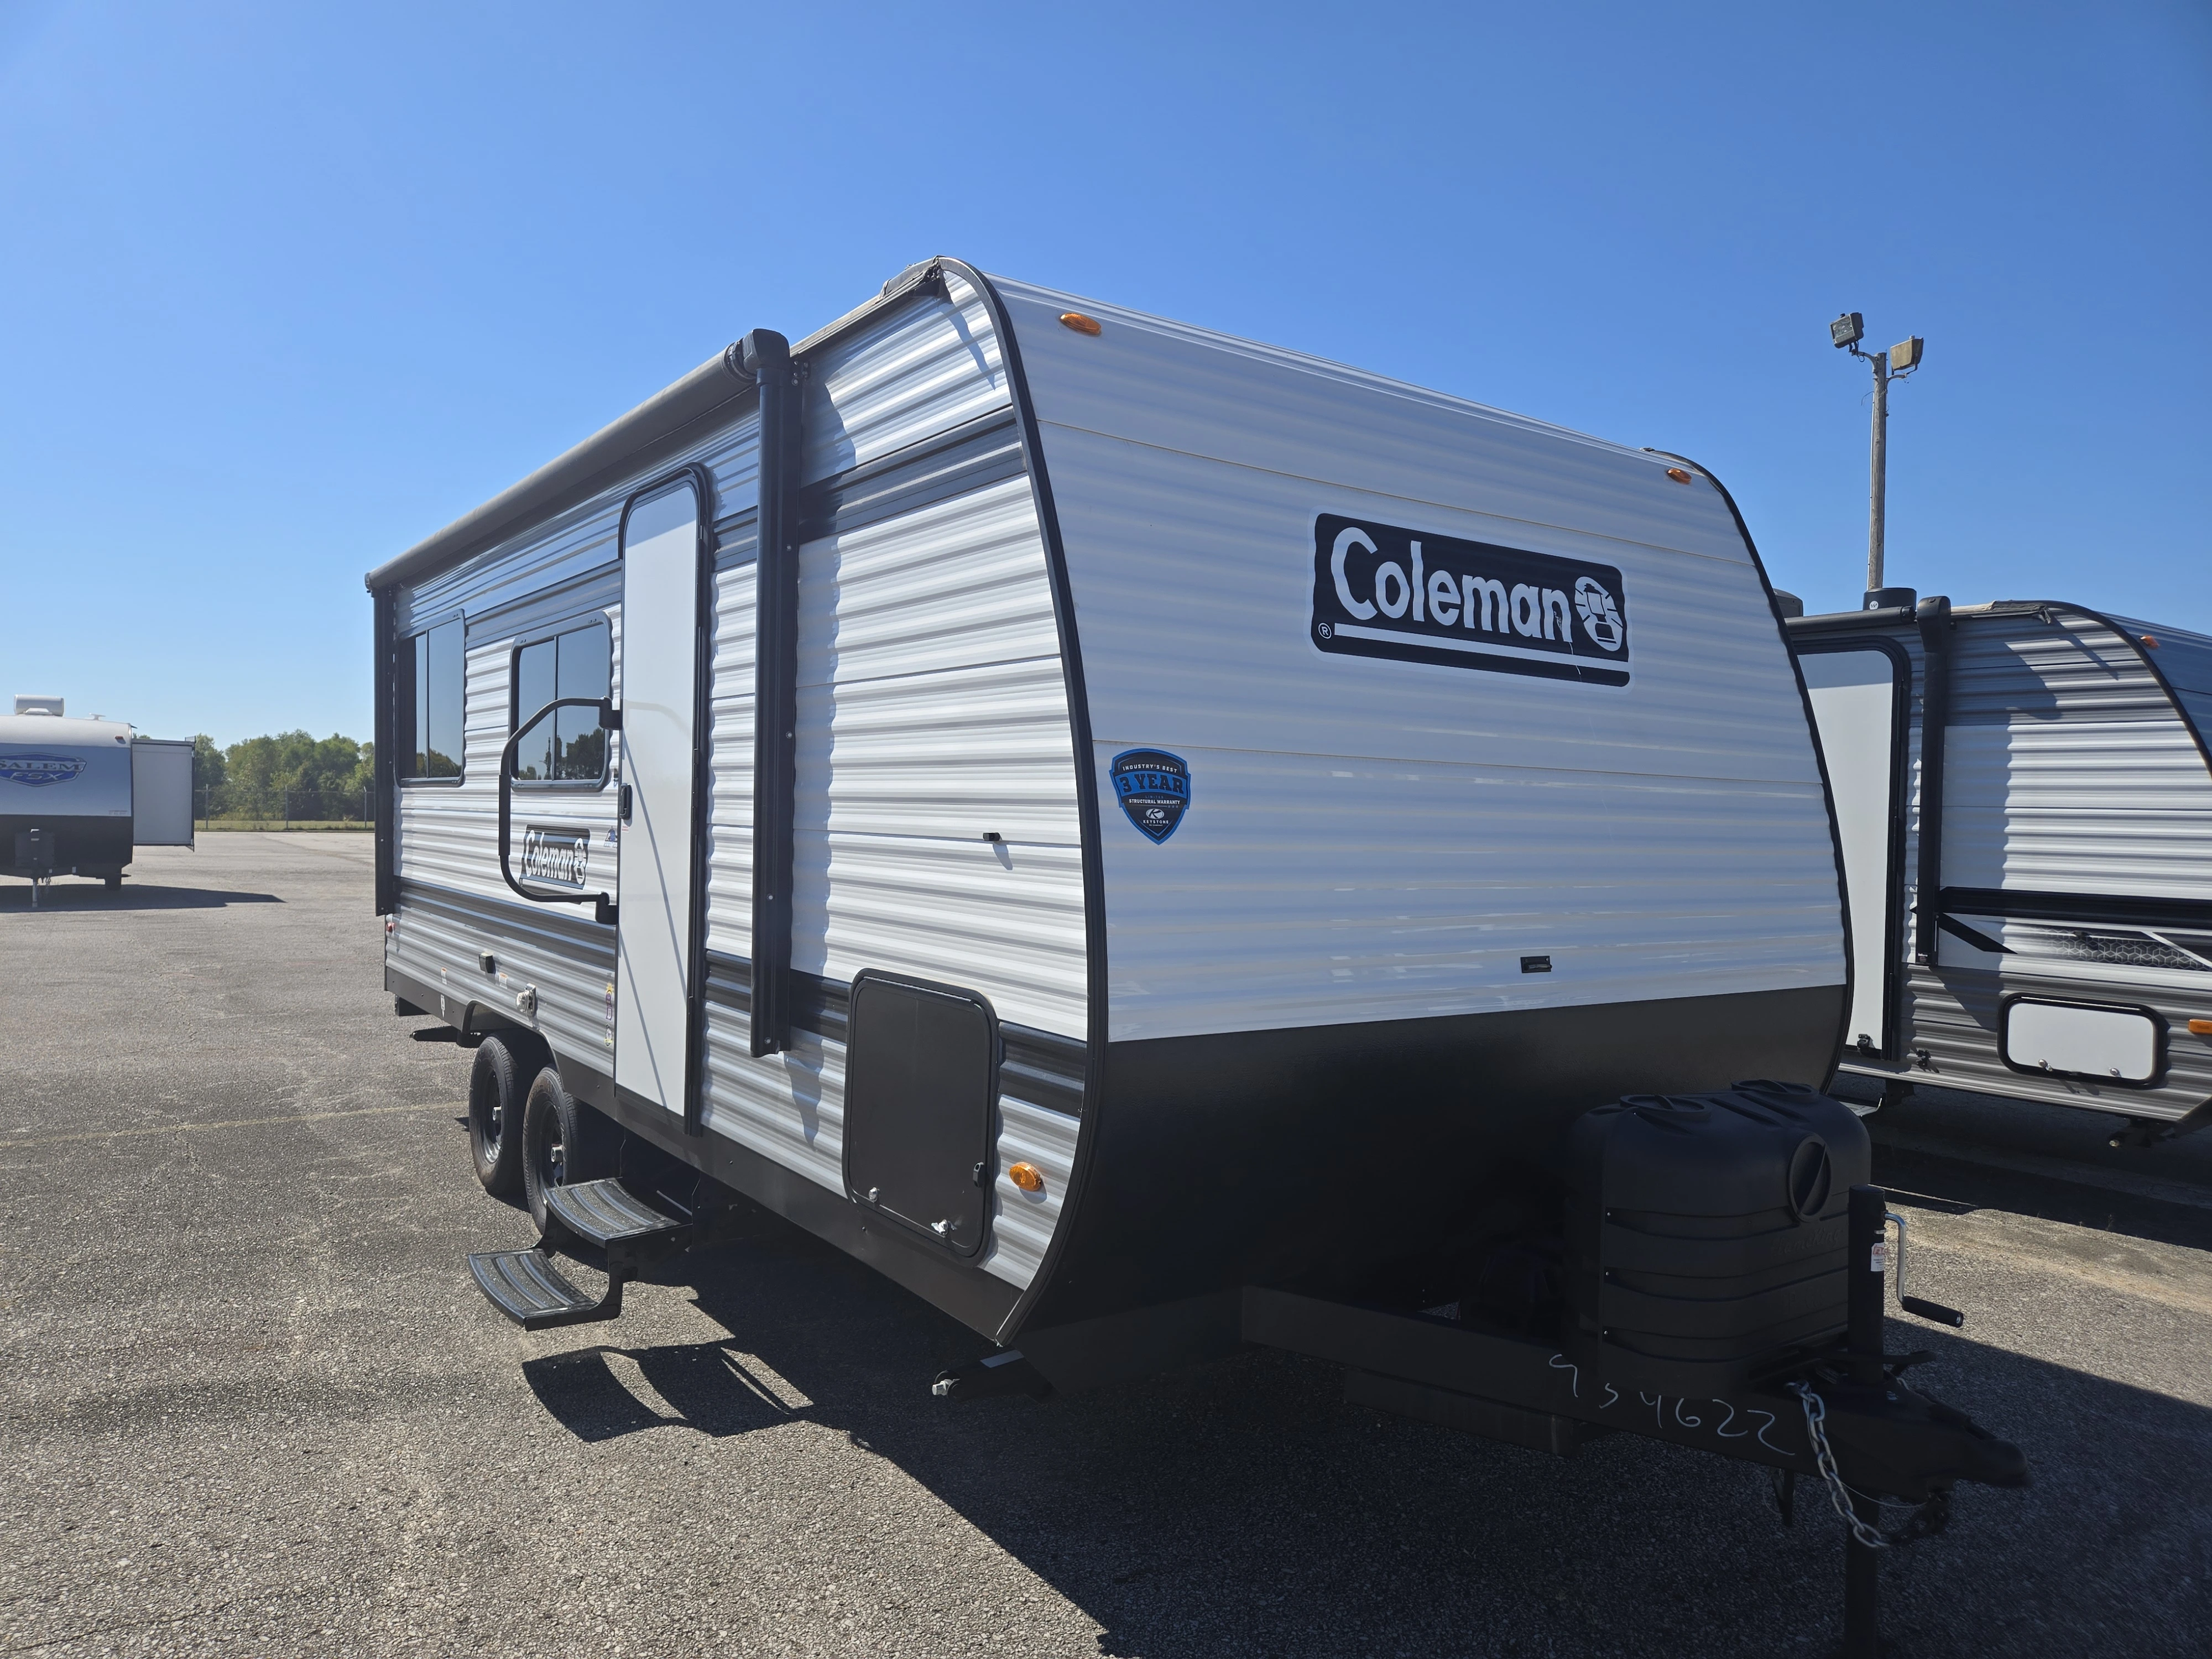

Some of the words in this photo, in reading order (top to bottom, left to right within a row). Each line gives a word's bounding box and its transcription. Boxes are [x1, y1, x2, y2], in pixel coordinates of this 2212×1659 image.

[1331, 526, 1573, 643] Coleman
[1119, 776, 1132, 793] 3
[1134, 773, 1184, 794] YEAR
[524, 830, 574, 881] Coleman
